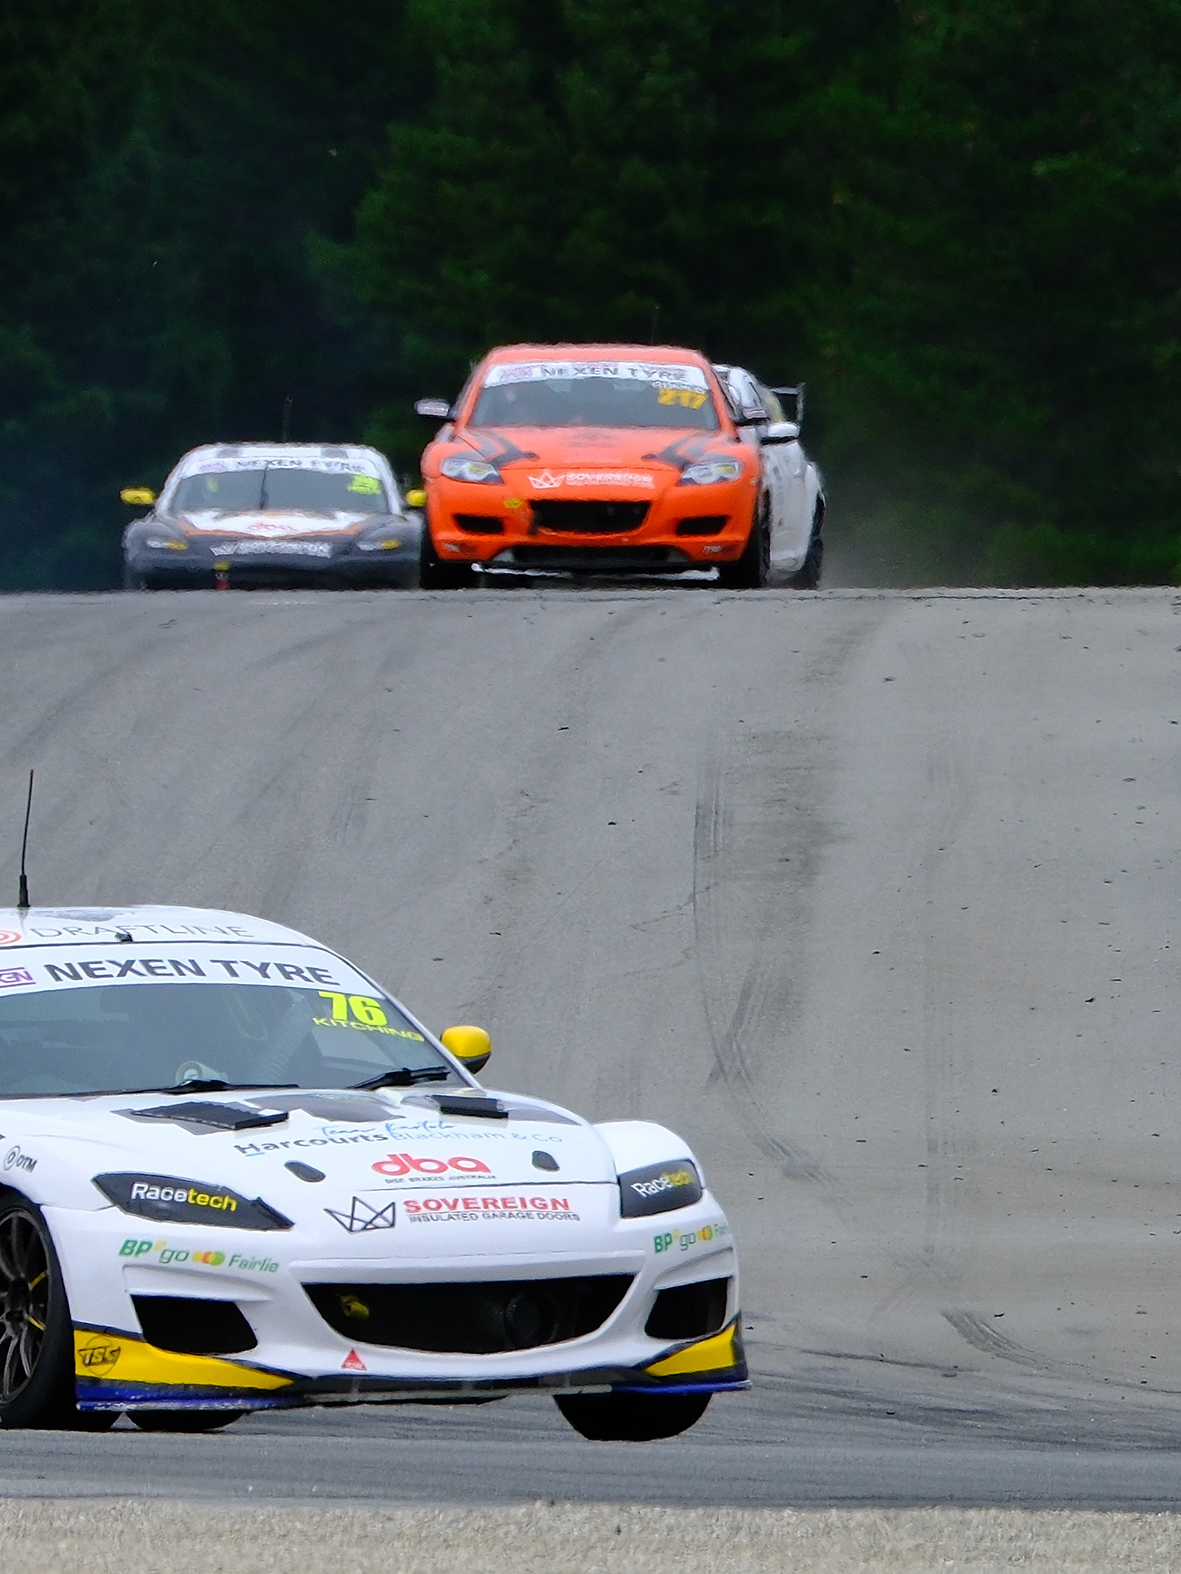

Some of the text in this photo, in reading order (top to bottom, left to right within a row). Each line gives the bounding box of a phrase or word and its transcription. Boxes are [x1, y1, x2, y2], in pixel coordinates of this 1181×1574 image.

[30, 924, 255, 939] DRAFTLINE
[44, 959, 341, 986] NEXEN TYRE
[318, 990, 388, 1027] 76
[312, 1017, 425, 1042] KITCHING
[234, 1132, 388, 1155] Harcourts
[372, 1153, 492, 1177] dba
[131, 1182, 237, 1212] Racetech
[404, 1196, 570, 1214] SOVEREIGN
[409, 1211, 580, 1225] INSULATED GARAGE DOORS
[228, 1254, 280, 1273] Fairlie
